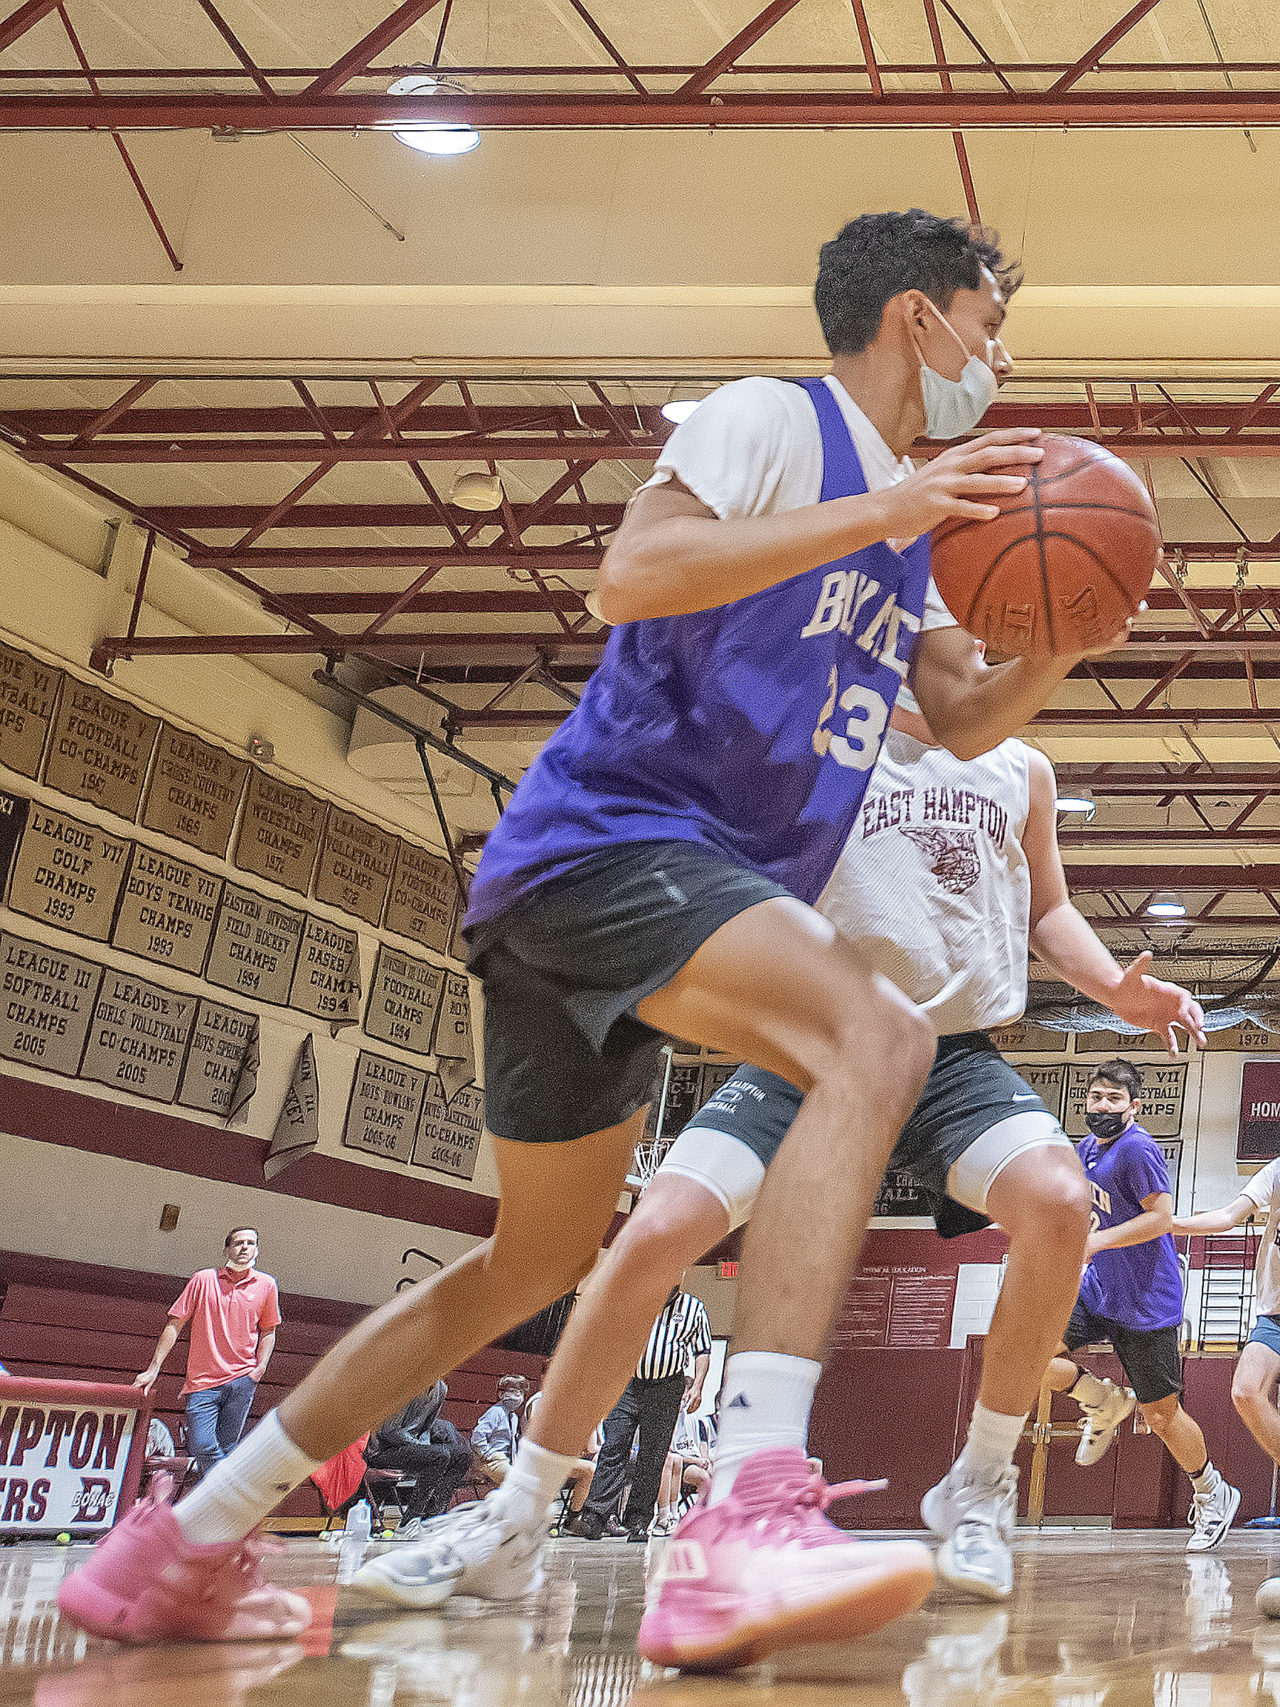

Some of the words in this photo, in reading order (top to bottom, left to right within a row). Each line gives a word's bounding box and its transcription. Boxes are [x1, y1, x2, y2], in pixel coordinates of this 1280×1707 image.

[71, 691, 130, 731] LEAGUE
[67, 715, 139, 763] FOOTBALL
[60, 738, 140, 785] CO-CHAMPS
[862, 788, 916, 840] EAST
[922, 785, 1009, 849] HAMPTON
[32, 812, 95, 852] LEAGUE
[101, 841, 125, 865] VII
[52, 847, 93, 876] GOLF
[137, 853, 193, 889] LEAGUE
[197, 877, 217, 900] VII
[34, 866, 98, 905] CHAMPS
[128, 876, 164, 903] BOYS
[168, 890, 215, 923] TENNIS
[44, 896, 77, 922] 1993
[139, 906, 194, 939] CHAMPS
[224, 915, 251, 940] FIELD
[306, 923, 355, 955] LEAGUE
[147, 934, 174, 958] 1993
[228, 942, 278, 974] CHAMPS
[6, 945, 70, 982] LEAGUE
[74, 967, 93, 990] III
[3, 972, 82, 1013] SOFTBALL
[112, 980, 171, 1016] LEAGUE
[175, 1001, 188, 1020] V
[317, 993, 351, 1013] 1994
[382, 976, 434, 1009] FOOTBALL
[446, 979, 470, 999] LEA
[6, 1002, 69, 1036] CHAMPS
[96, 1001, 128, 1026] GIRLS
[130, 1011, 188, 1046] VOLLEYBALL
[384, 997, 424, 1025] CHAMPS
[13, 1031, 48, 1057] 2005
[99, 1028, 178, 1068] CO-CHAMPS
[115, 1060, 151, 1085] 2005
[203, 1059, 240, 1085] CHAM
[365, 1060, 408, 1089] LEAGUE
[1156, 1071, 1180, 1083] VII
[1069, 1086, 1089, 1100] GIR
[363, 1106, 405, 1130] CHAMPS
[71, 1490, 116, 1508] BONAC
